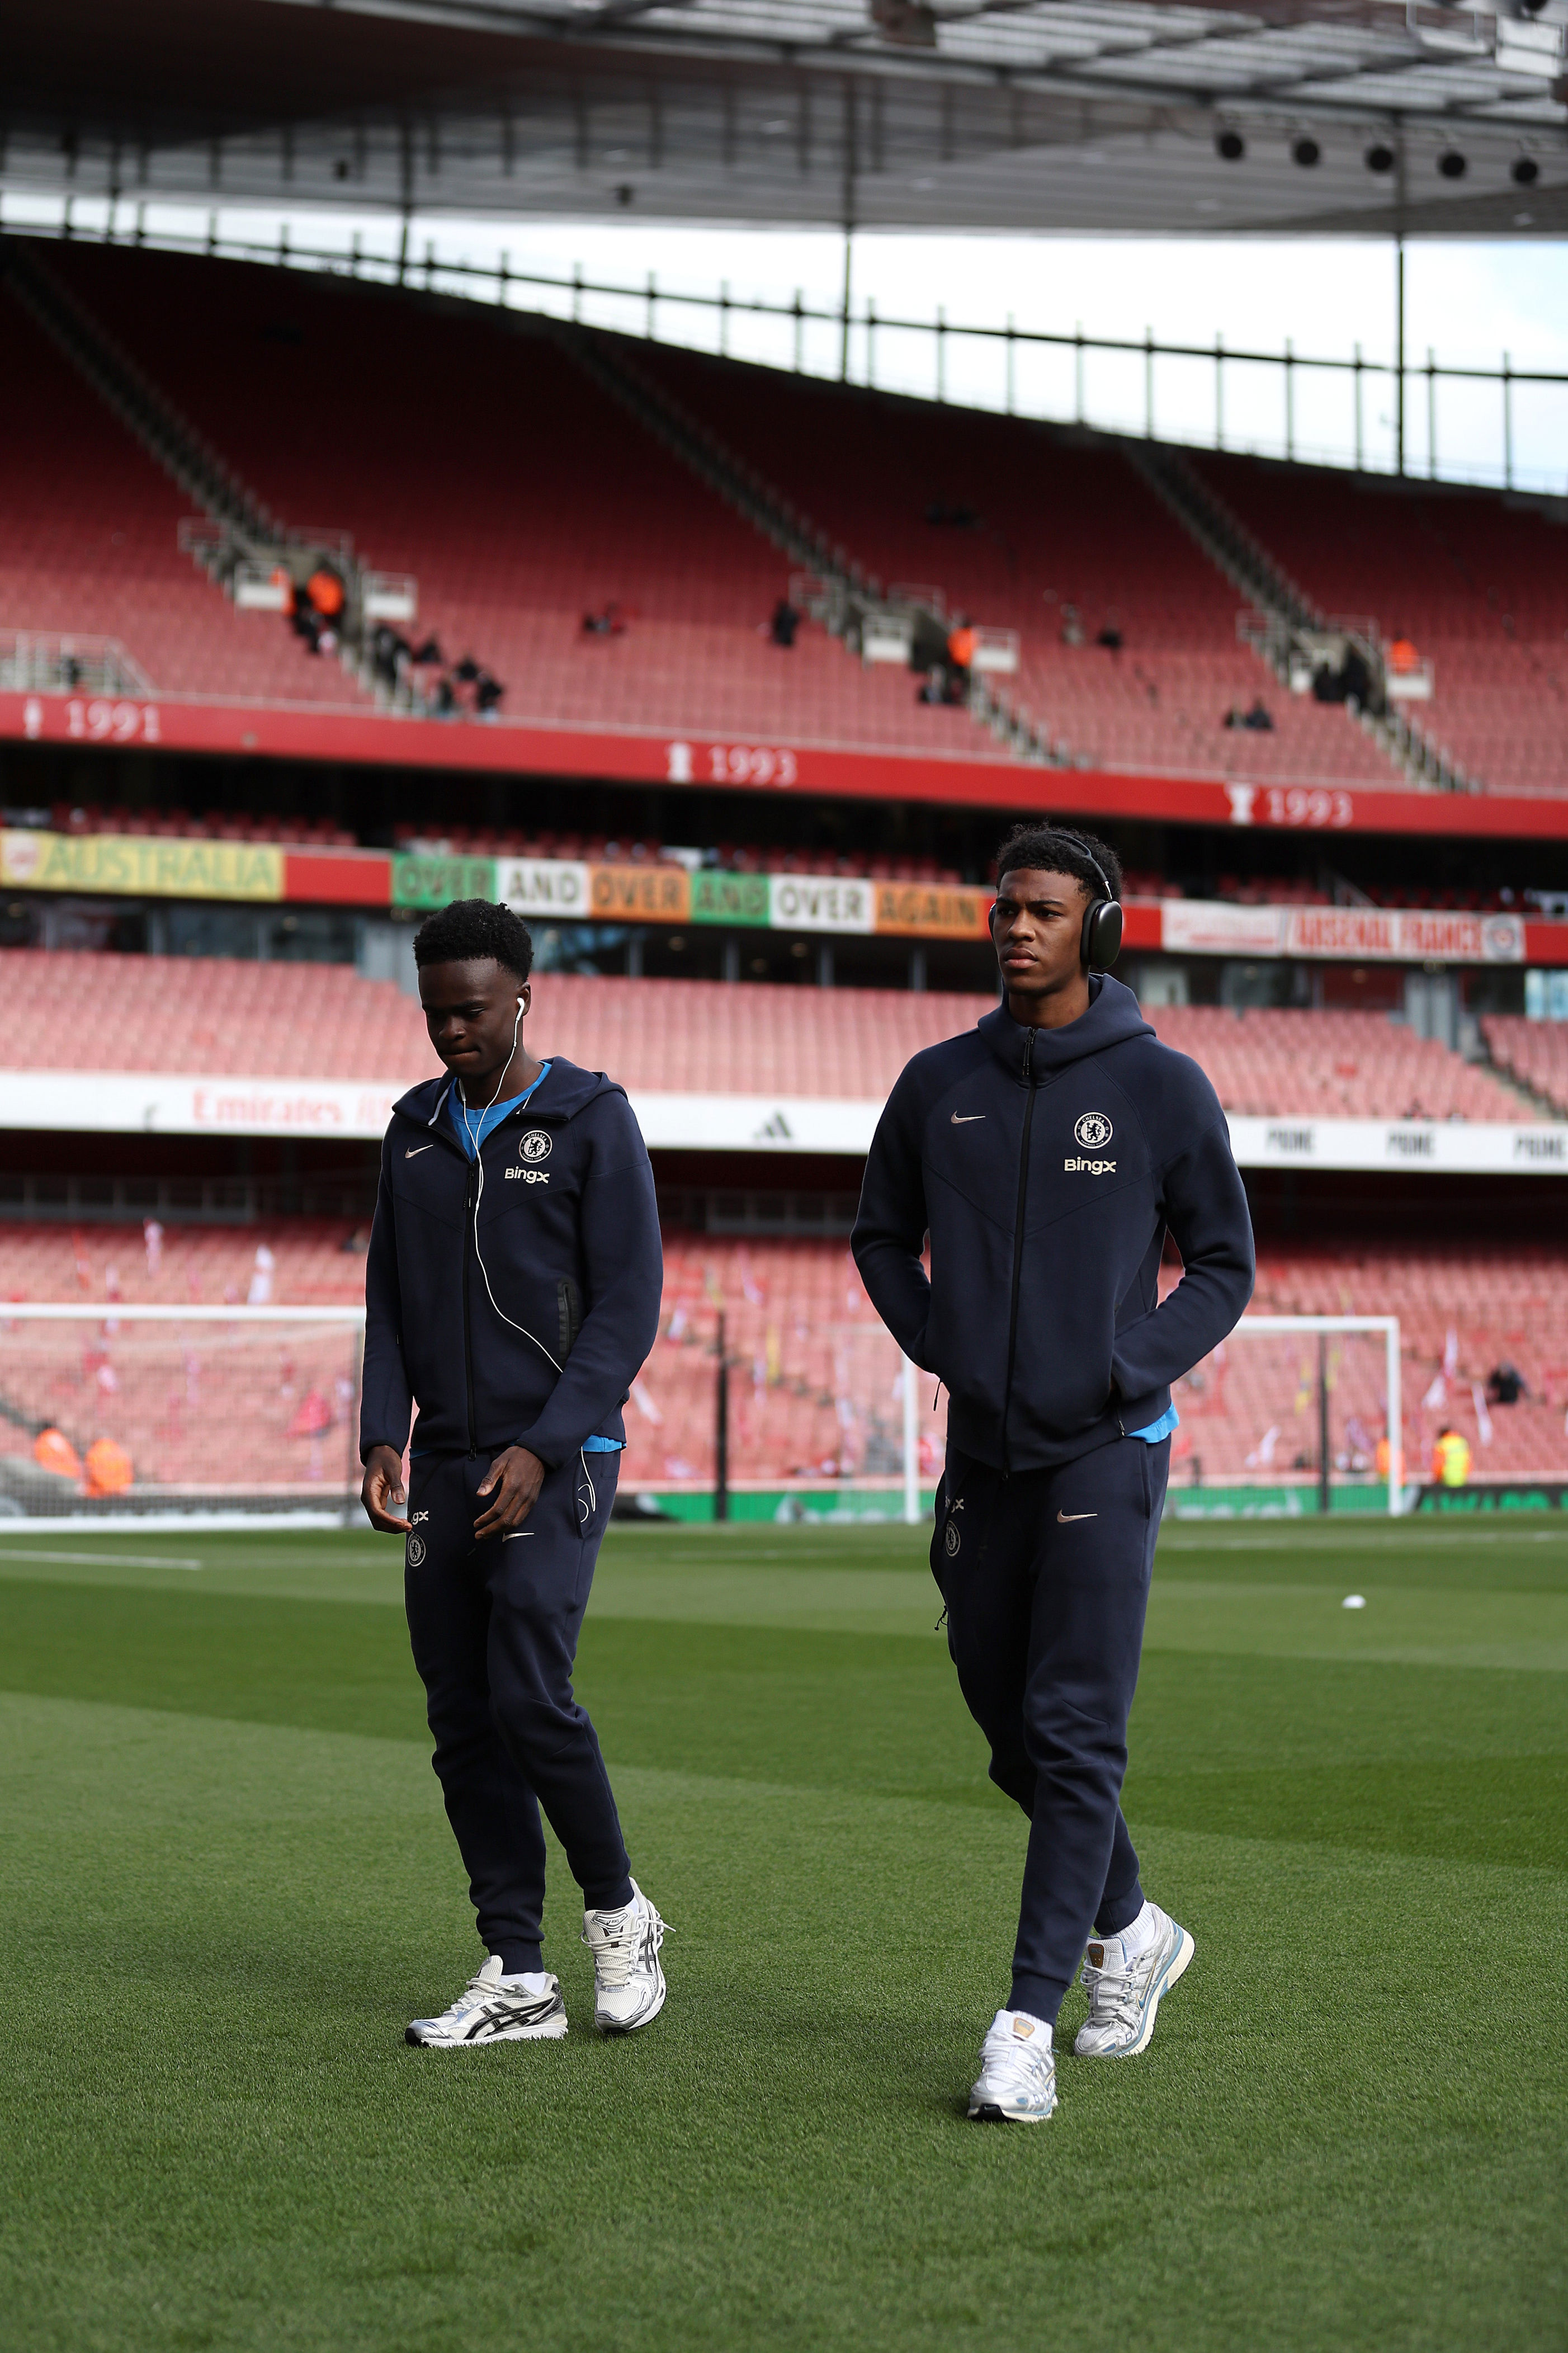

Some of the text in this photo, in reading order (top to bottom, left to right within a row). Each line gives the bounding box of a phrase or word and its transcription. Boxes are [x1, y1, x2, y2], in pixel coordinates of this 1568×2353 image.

[64, 699, 161, 743] 1991
[710, 745, 797, 788] 1993
[1268, 788, 1353, 828] 1993
[43, 839, 274, 892] AUSTRALIA
[398, 856, 979, 931] OVER AND OVER AND OVER AGAIN
[527, 1133, 547, 1142] CHELSEA
